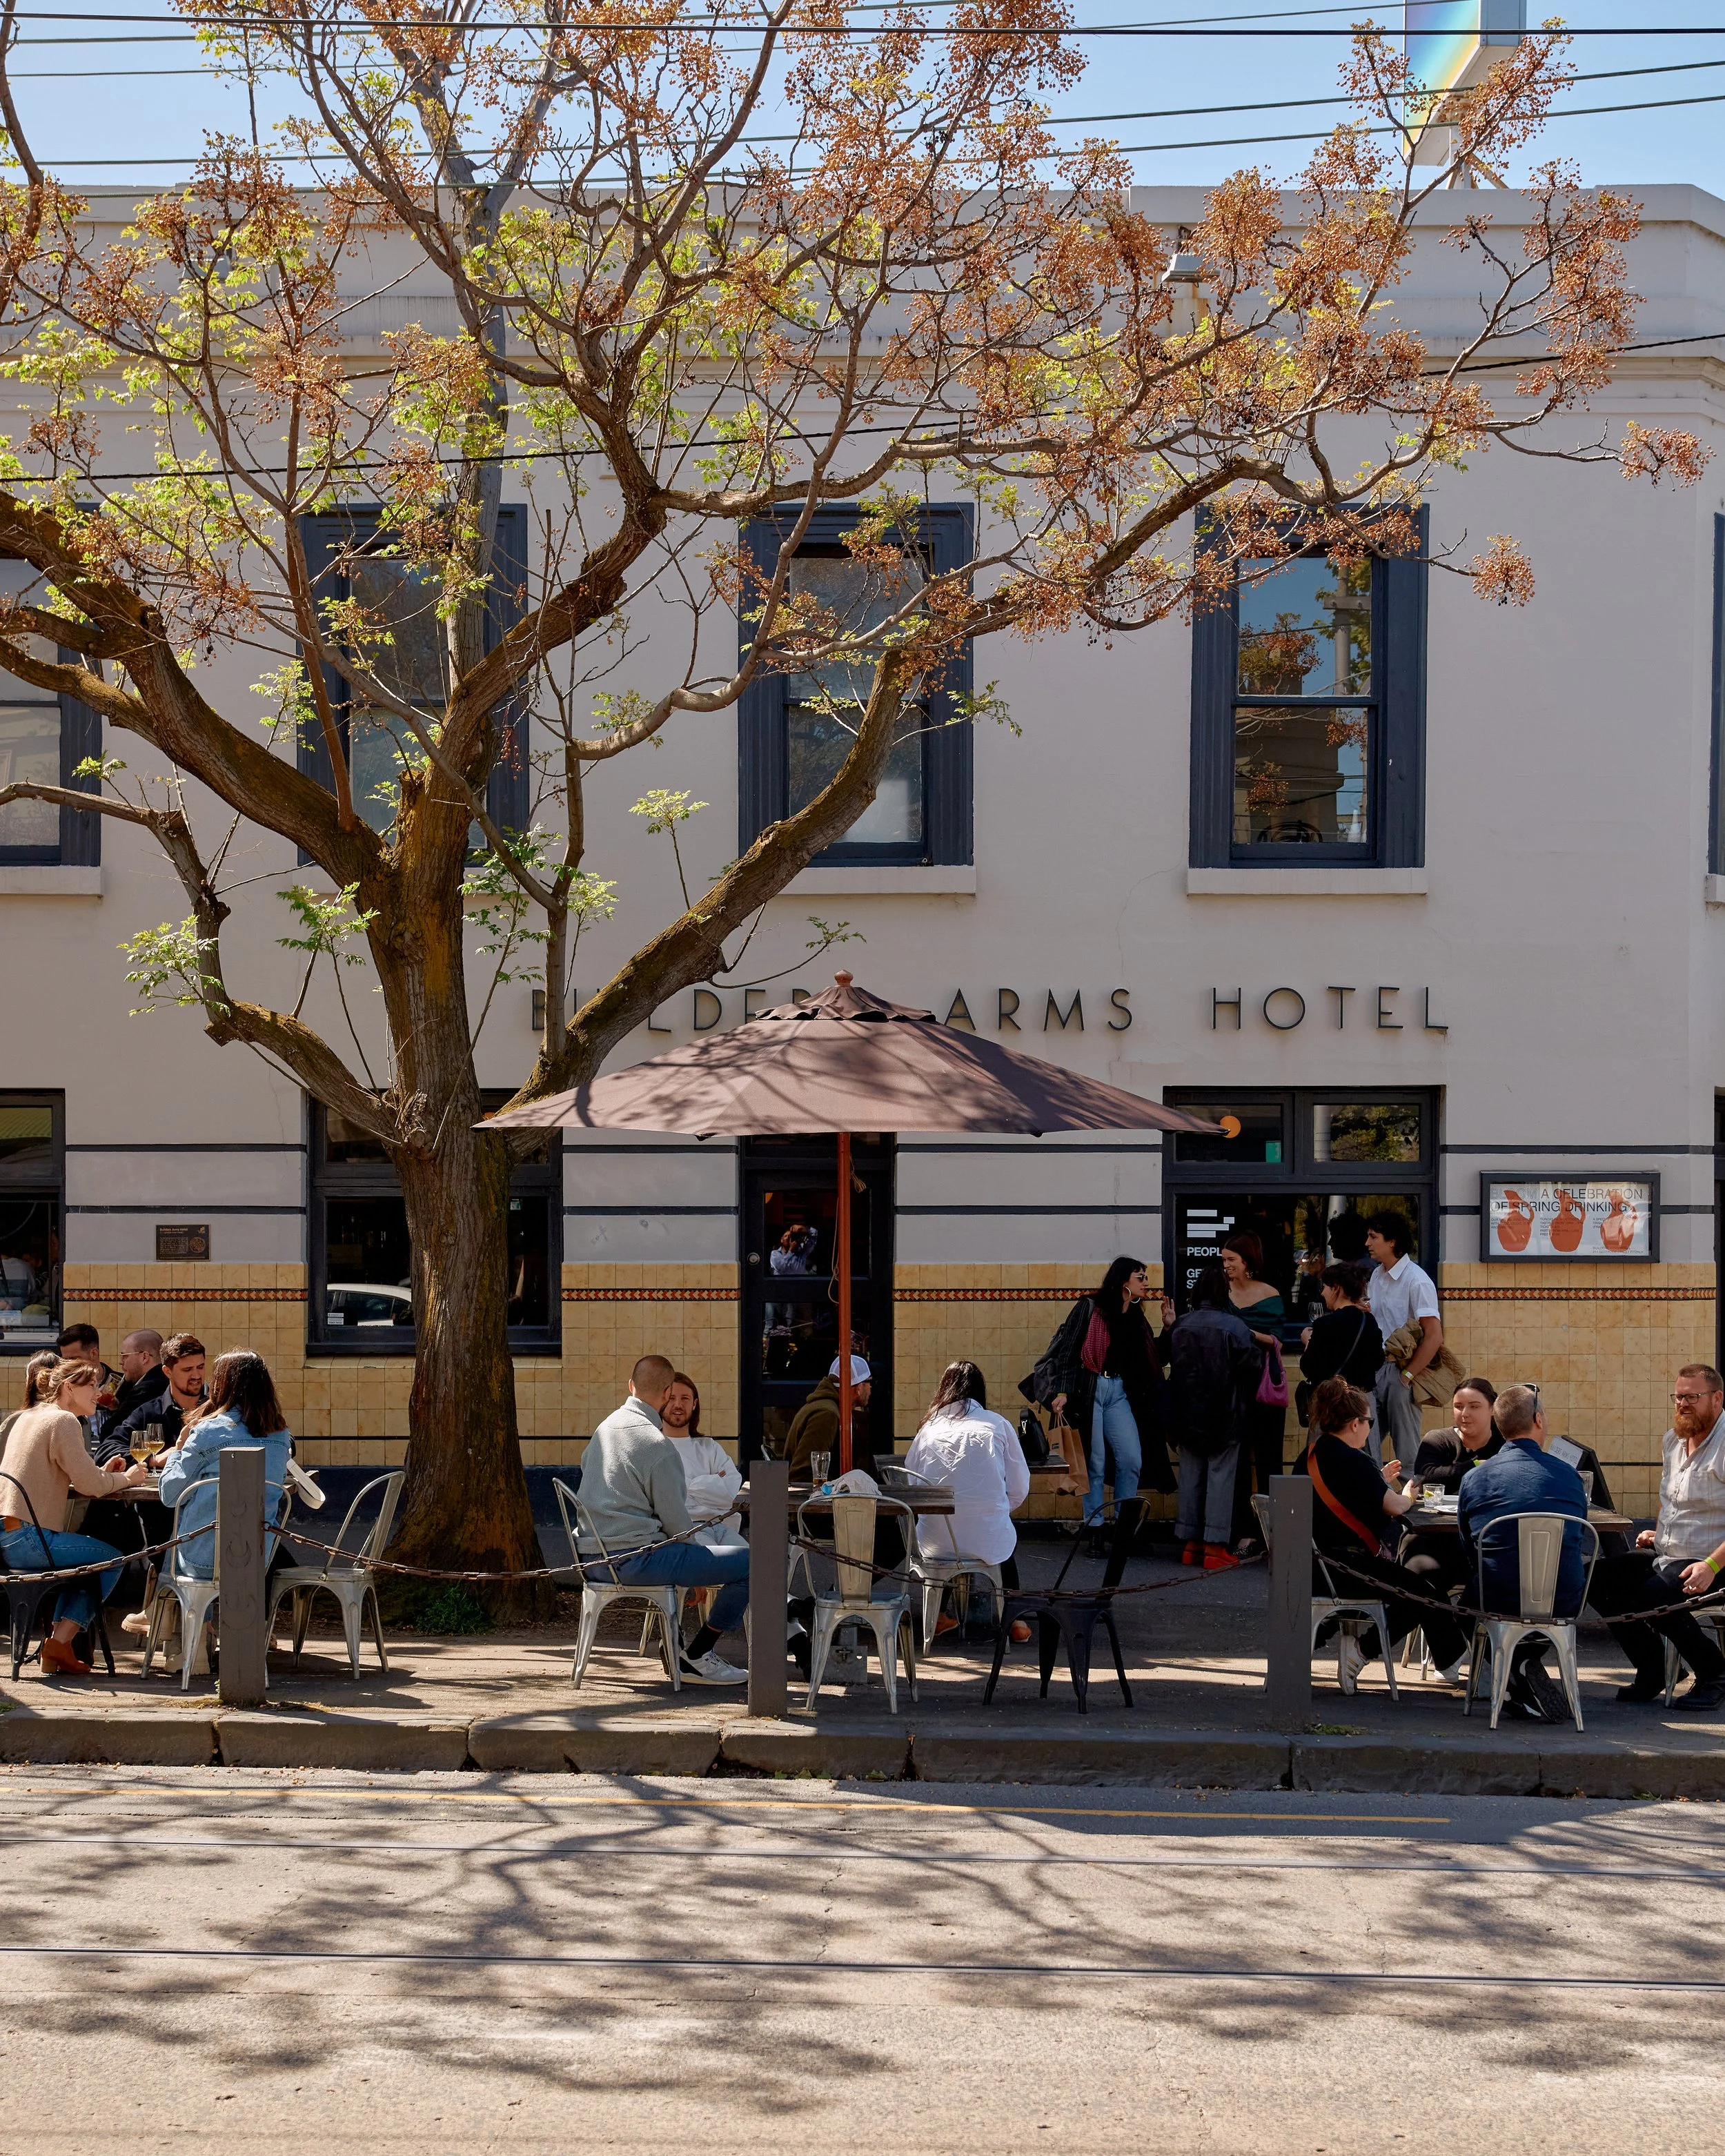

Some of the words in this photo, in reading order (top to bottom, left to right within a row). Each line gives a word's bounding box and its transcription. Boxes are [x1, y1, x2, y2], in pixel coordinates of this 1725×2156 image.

[945, 987, 1132, 1032] ARMS
[1212, 986, 1449, 1034] HOTEL
[1490, 1188, 1537, 1200] BLOM
[1541, 1189, 1549, 1199] A
[1553, 1188, 1643, 1200] CELEBRATION
[1490, 1201, 1508, 1212] OF
[1512, 1200, 1561, 1212] SPRING
[1565, 1200, 1628, 1212] DRINKING
[1187, 1247, 1222, 1256] PEOPL
